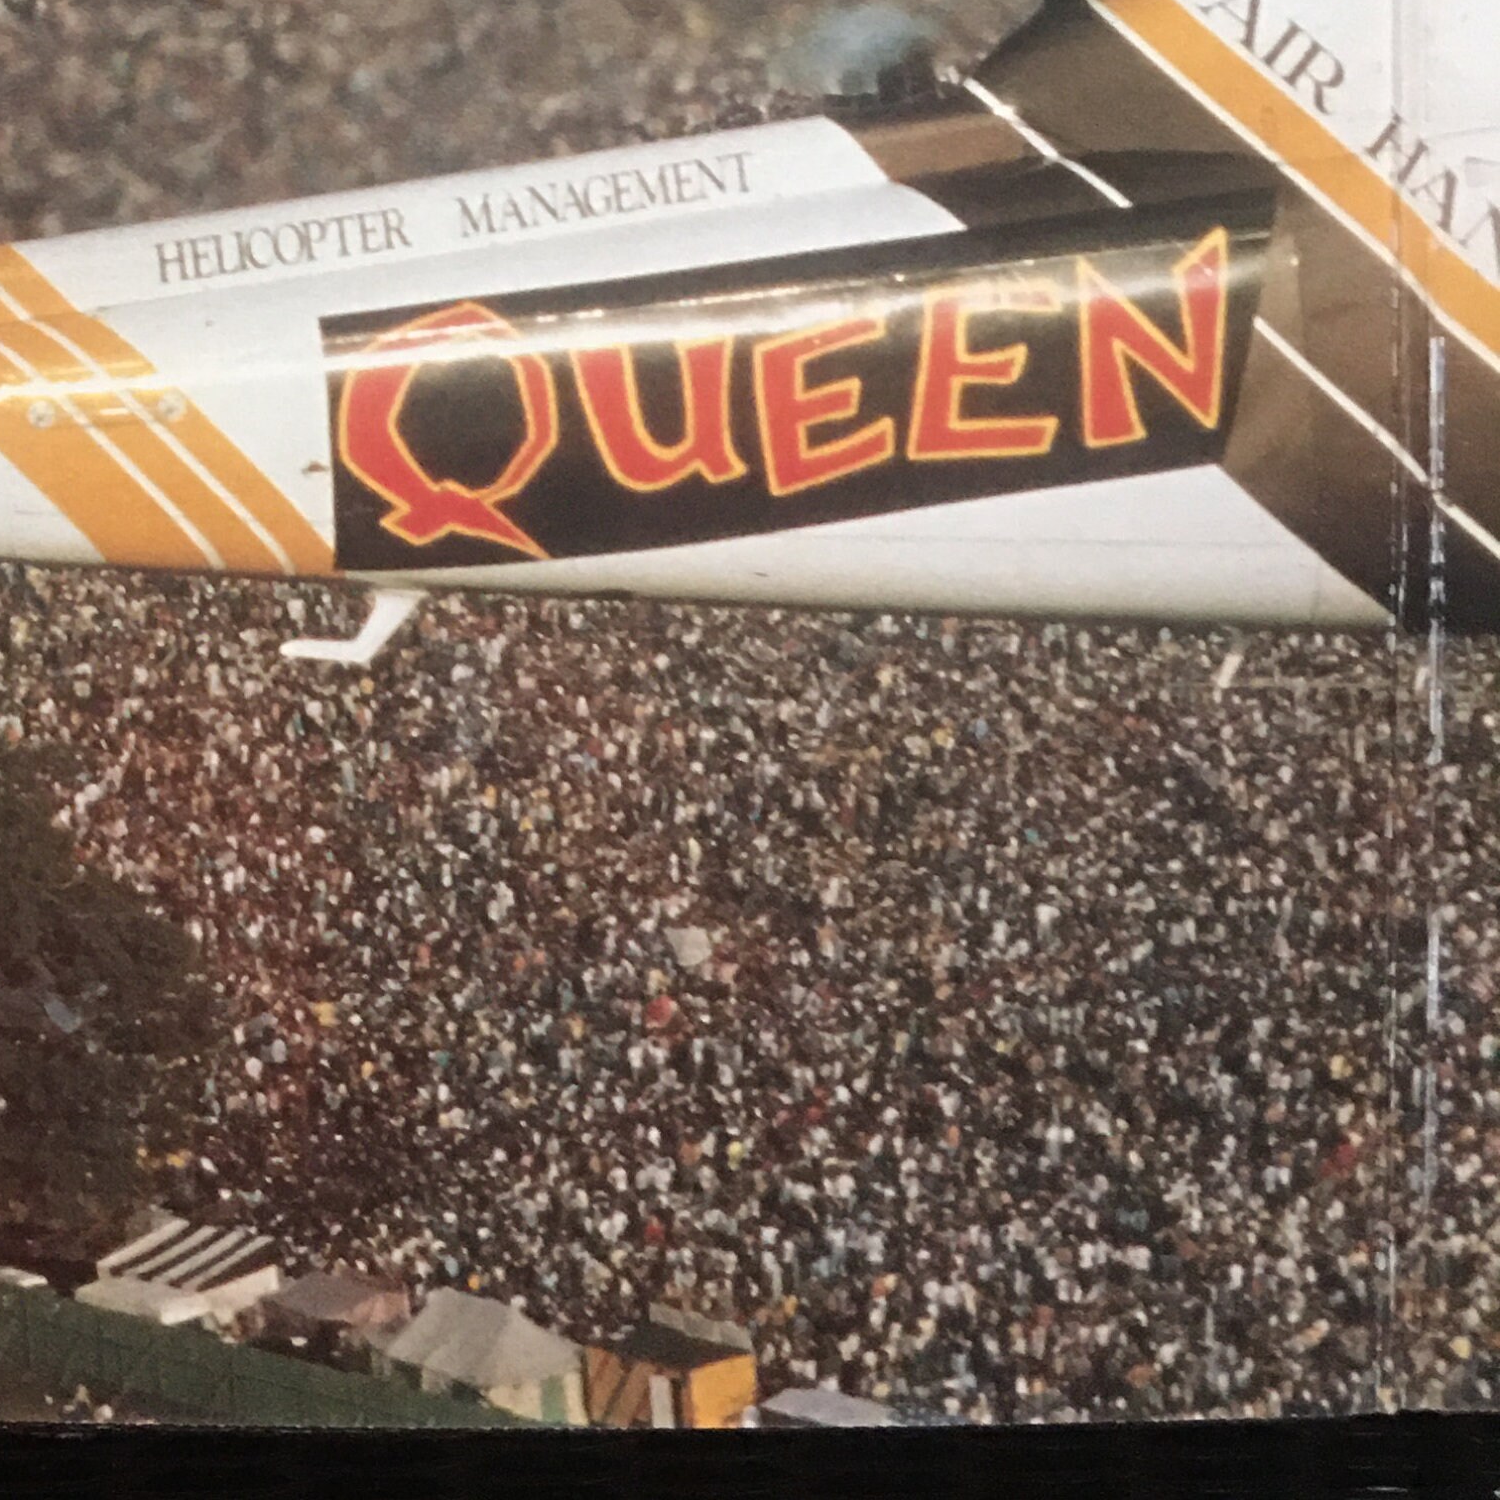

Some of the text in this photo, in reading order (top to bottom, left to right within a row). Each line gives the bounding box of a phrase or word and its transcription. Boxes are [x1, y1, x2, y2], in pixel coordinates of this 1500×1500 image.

[155, 151, 753, 285] HELICOPTER MANAGEMENT
[338, 226, 1229, 560] QUEEN
